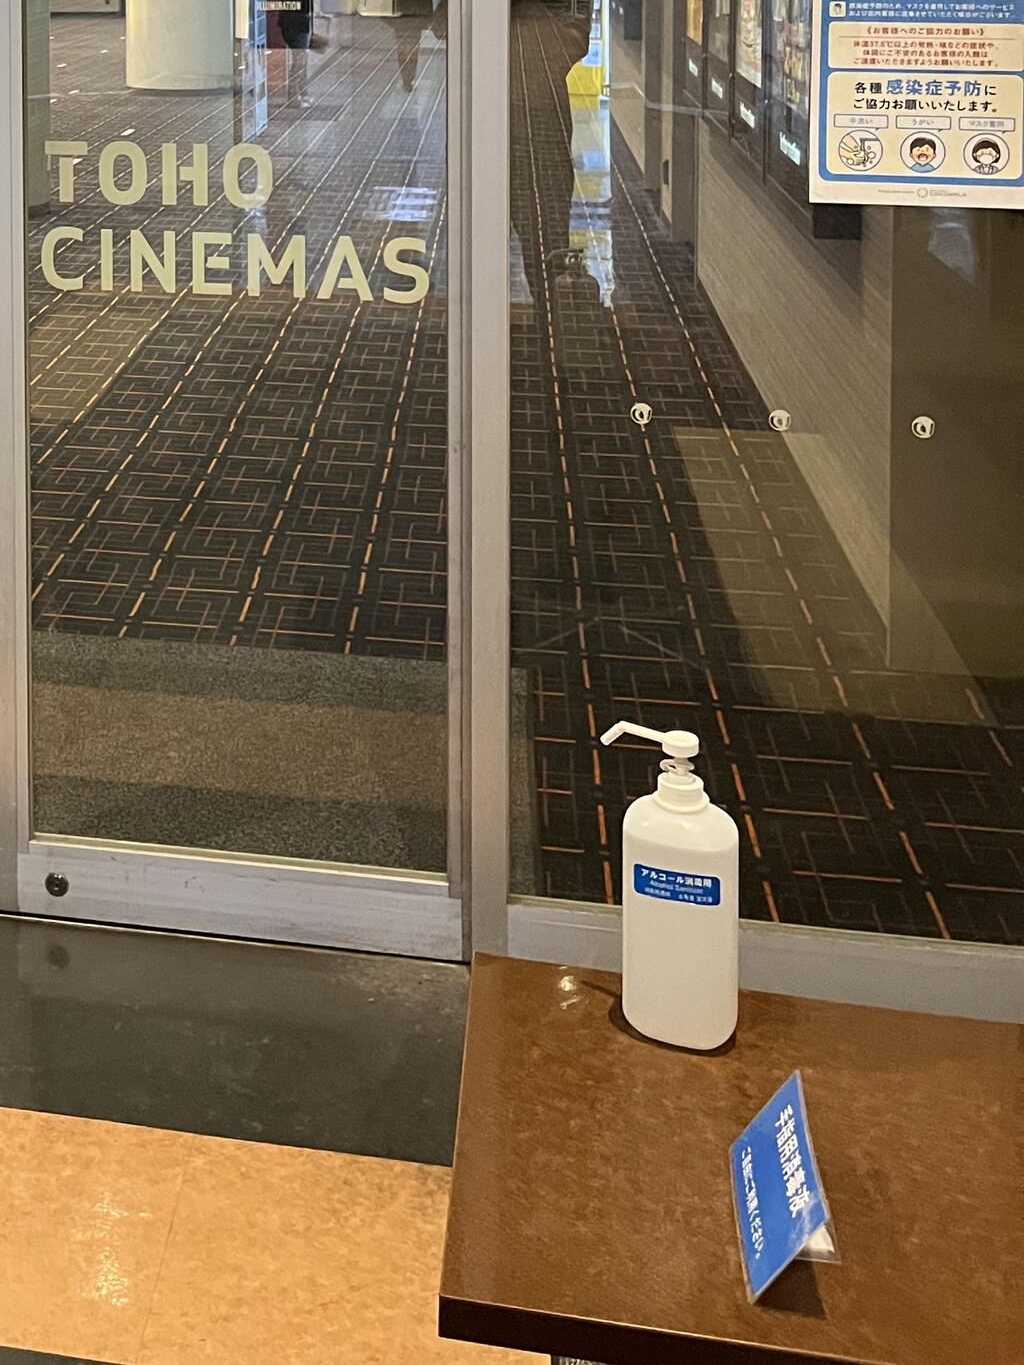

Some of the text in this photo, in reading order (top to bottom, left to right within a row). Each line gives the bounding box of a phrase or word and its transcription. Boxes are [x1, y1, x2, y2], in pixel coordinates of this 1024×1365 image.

[853, 98, 998, 113] ご協力お願いいたします。
[854, 78, 997, 96] 各種感染症予防に
[44, 140, 273, 209] TOHO
[40, 226, 430, 304] CINEMAS
[775, 1104, 810, 1219] 手指用消毒液
